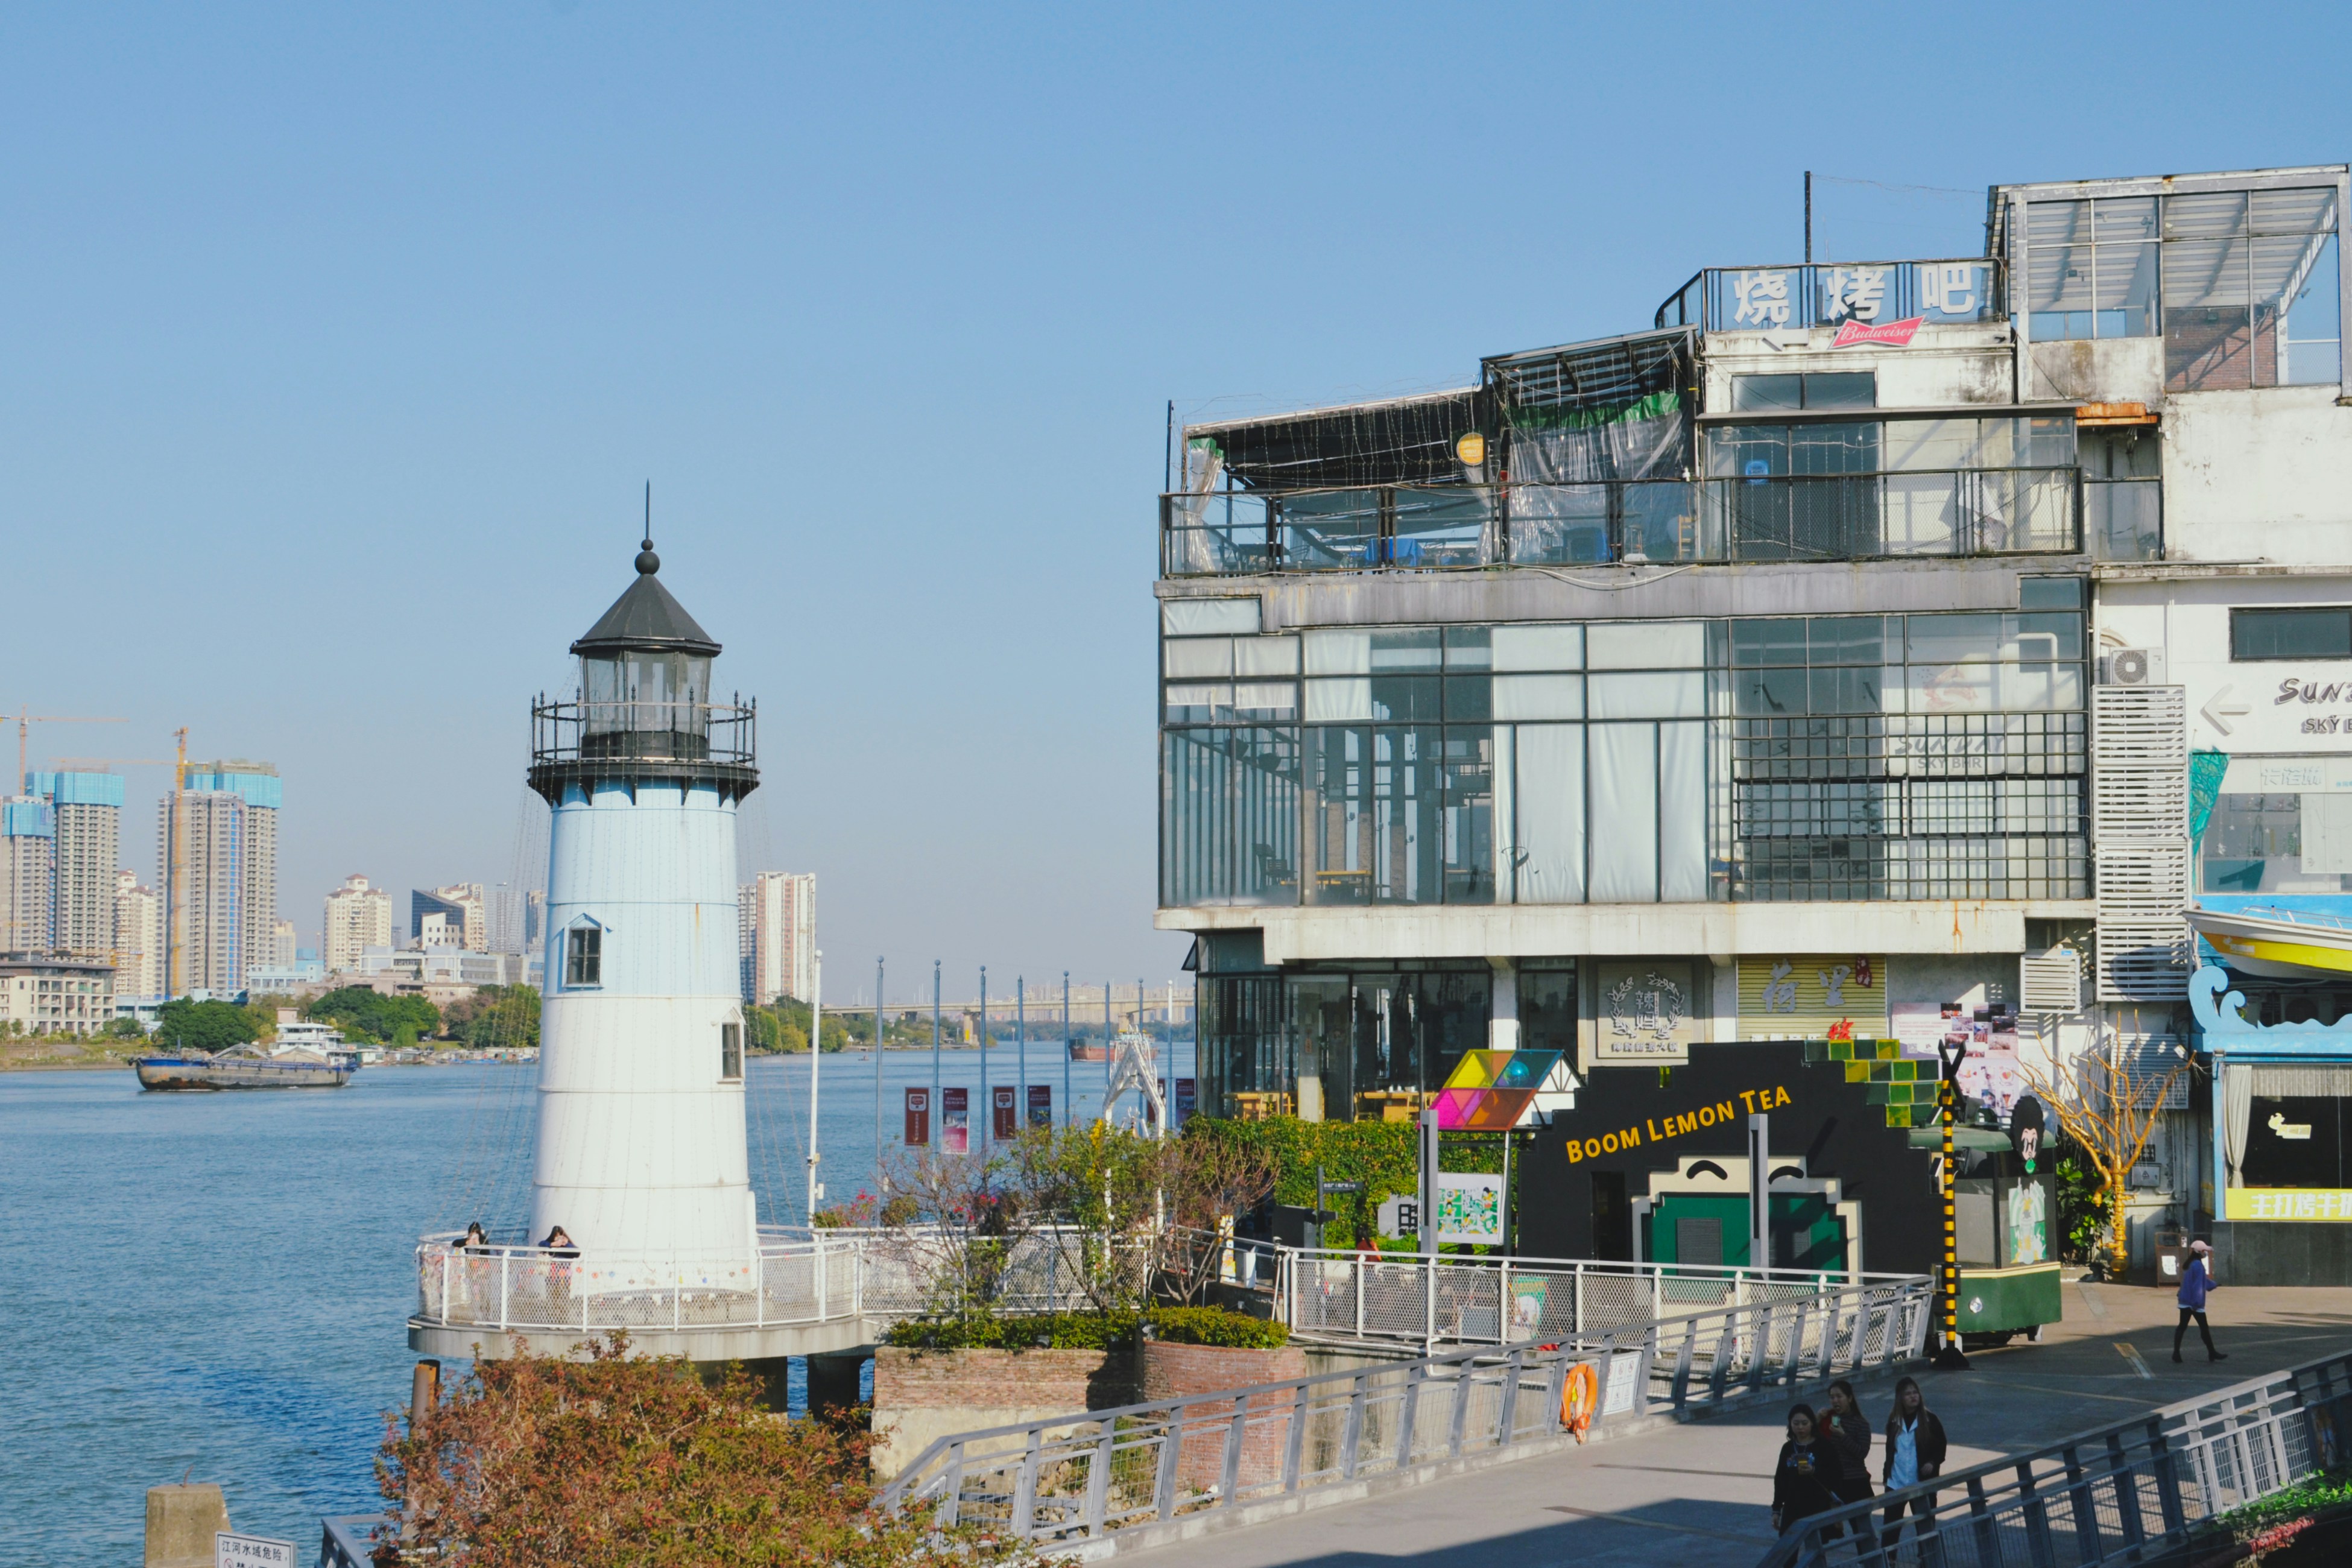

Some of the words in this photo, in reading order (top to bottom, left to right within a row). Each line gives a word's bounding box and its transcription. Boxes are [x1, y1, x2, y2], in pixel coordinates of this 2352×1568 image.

[1733, 263, 1975, 325] 烧烤吧
[1839, 324, 1917, 341] Budweiser
[2302, 716, 2341, 734] SKY
[1917, 757, 1946, 769] SKY
[1566, 1127, 1641, 1164] BOOM
[1646, 1100, 1735, 1142] LEMON
[1739, 1086, 1792, 1114] TEA
